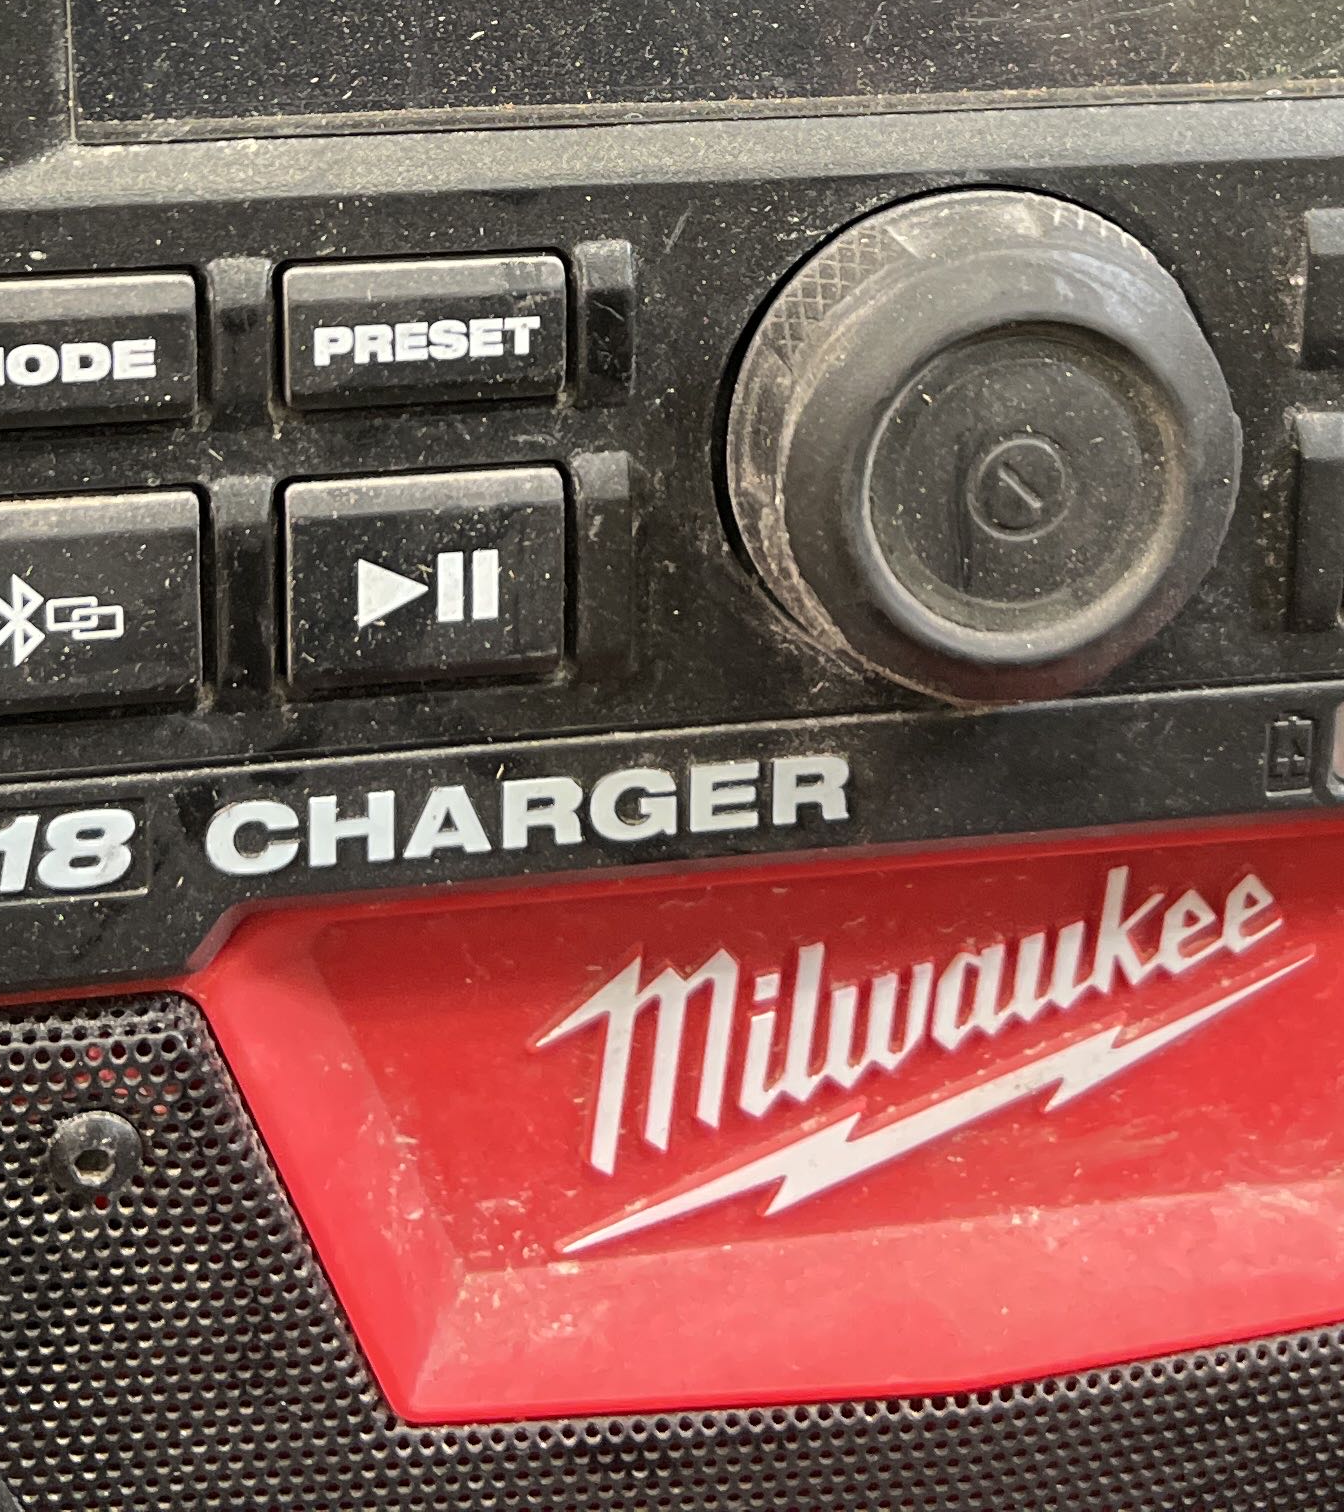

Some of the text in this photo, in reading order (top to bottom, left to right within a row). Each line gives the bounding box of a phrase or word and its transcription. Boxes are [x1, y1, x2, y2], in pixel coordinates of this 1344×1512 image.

[313, 316, 541, 367] PRESET
[205, 753, 849, 875] CHARGER
[533, 866, 1284, 1176] Milwaukee
